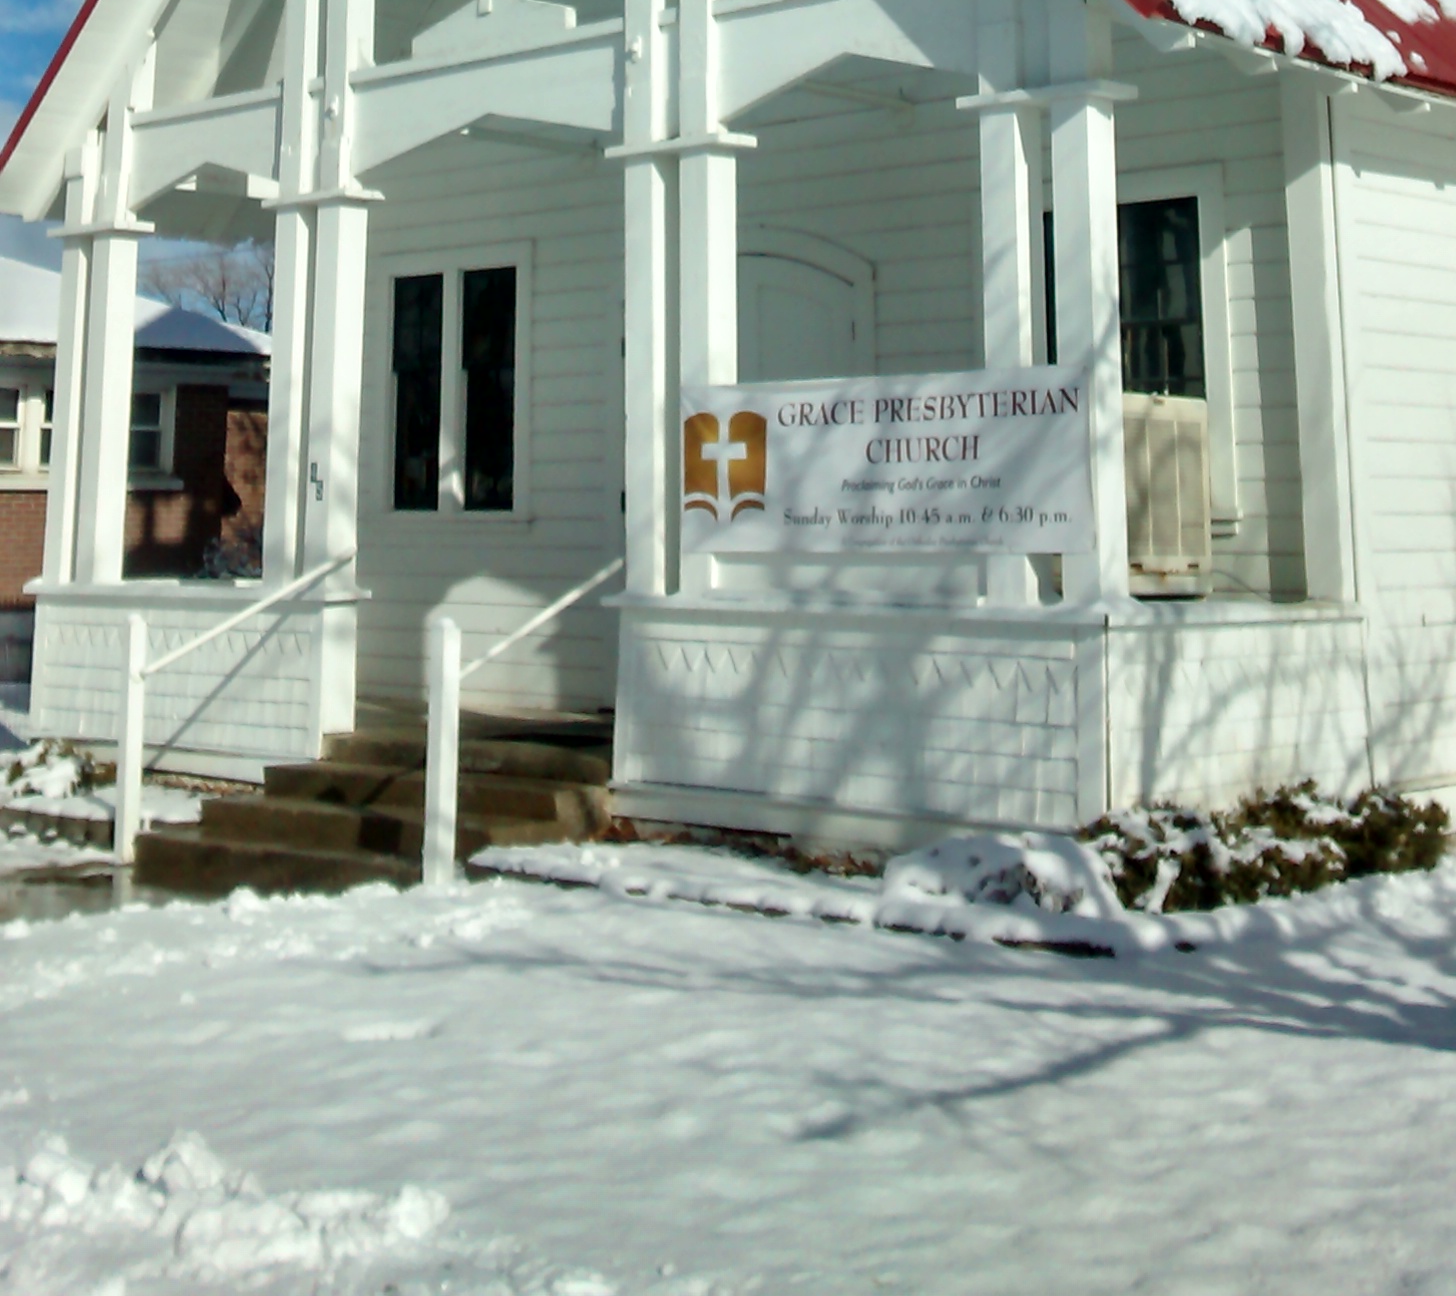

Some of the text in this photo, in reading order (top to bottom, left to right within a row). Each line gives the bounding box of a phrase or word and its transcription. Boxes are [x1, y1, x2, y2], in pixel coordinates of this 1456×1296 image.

[778, 388, 1079, 427] GRACE PRESBYTERIAN
[866, 436, 979, 464] CHURCH
[840, 476, 1002, 495] Proclaiming God's Grace in Christ
[783, 509, 833, 528] Sunday
[837, 509, 895, 529] Worship
[945, 512, 977, 524] a.m.
[981, 508, 994, 523] &
[998, 507, 1034, 524] 6:30
[1038, 511, 1073, 528] p.m.
